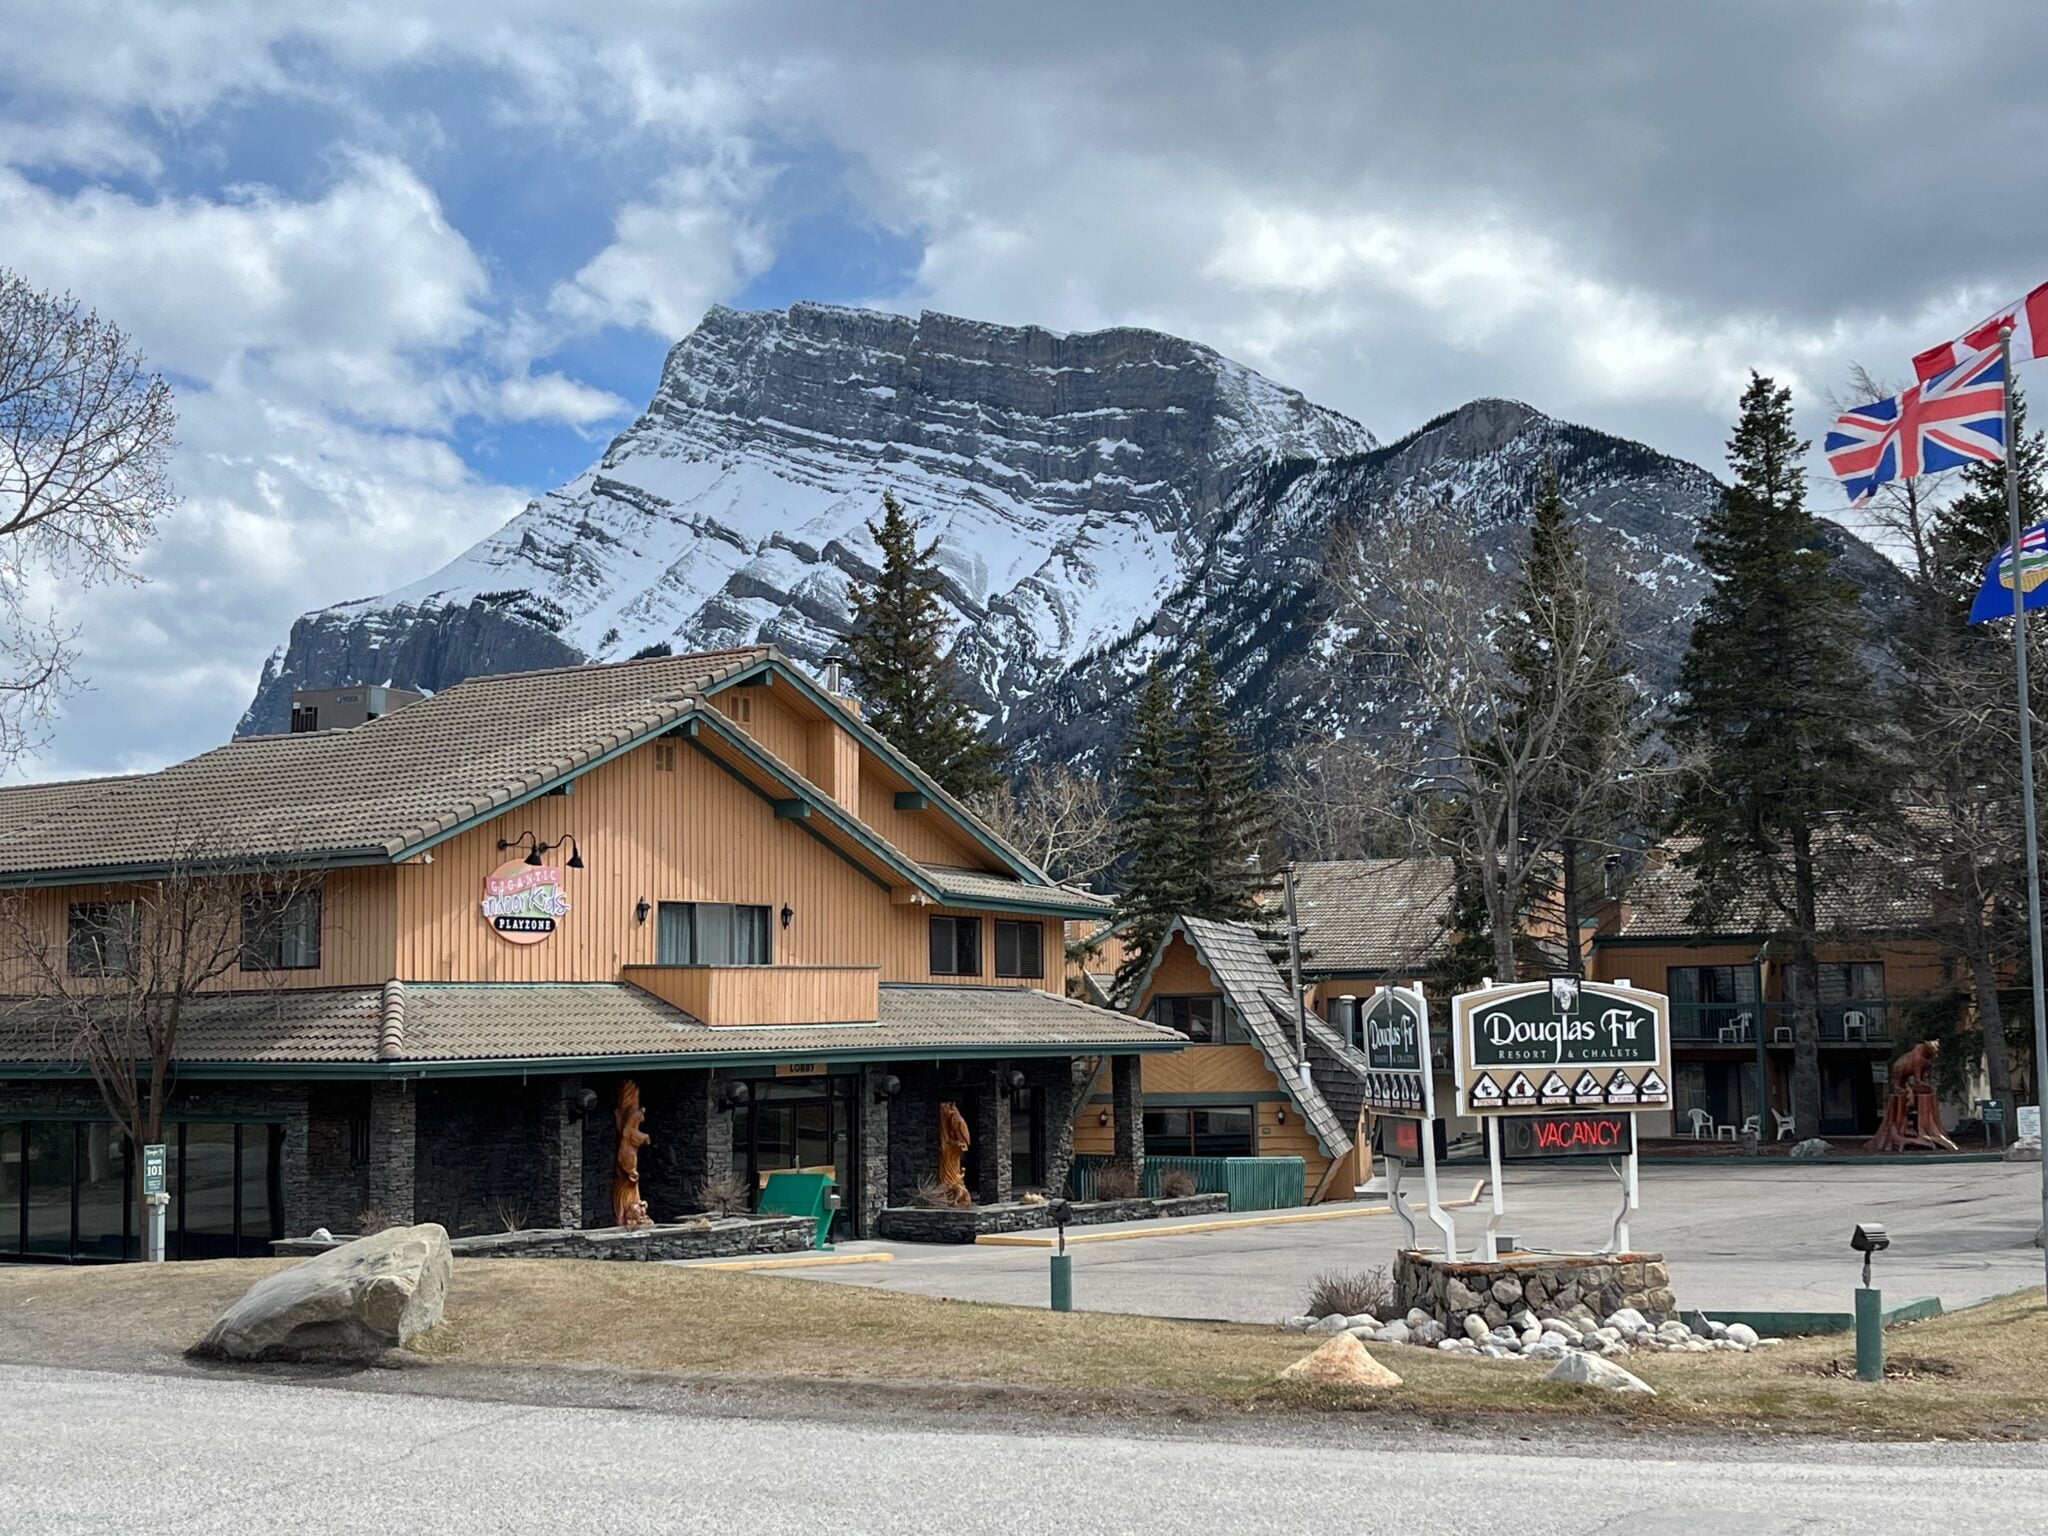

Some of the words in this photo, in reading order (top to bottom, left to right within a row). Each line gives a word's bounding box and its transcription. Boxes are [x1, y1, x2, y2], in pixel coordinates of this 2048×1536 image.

[499, 918, 551, 931] PLAYZONE
[1483, 1012, 1596, 1064] Douglas
[1600, 1008, 1646, 1047] Fir
[1498, 1049, 1547, 1059] RESORT
[1567, 1050, 1575, 1059] &
[1582, 1048, 1639, 1059] CHALETS
[789, 1063, 815, 1073] LOBBY
[1534, 1121, 1621, 1148] VACANCY
[146, 1165, 163, 1177] 101
